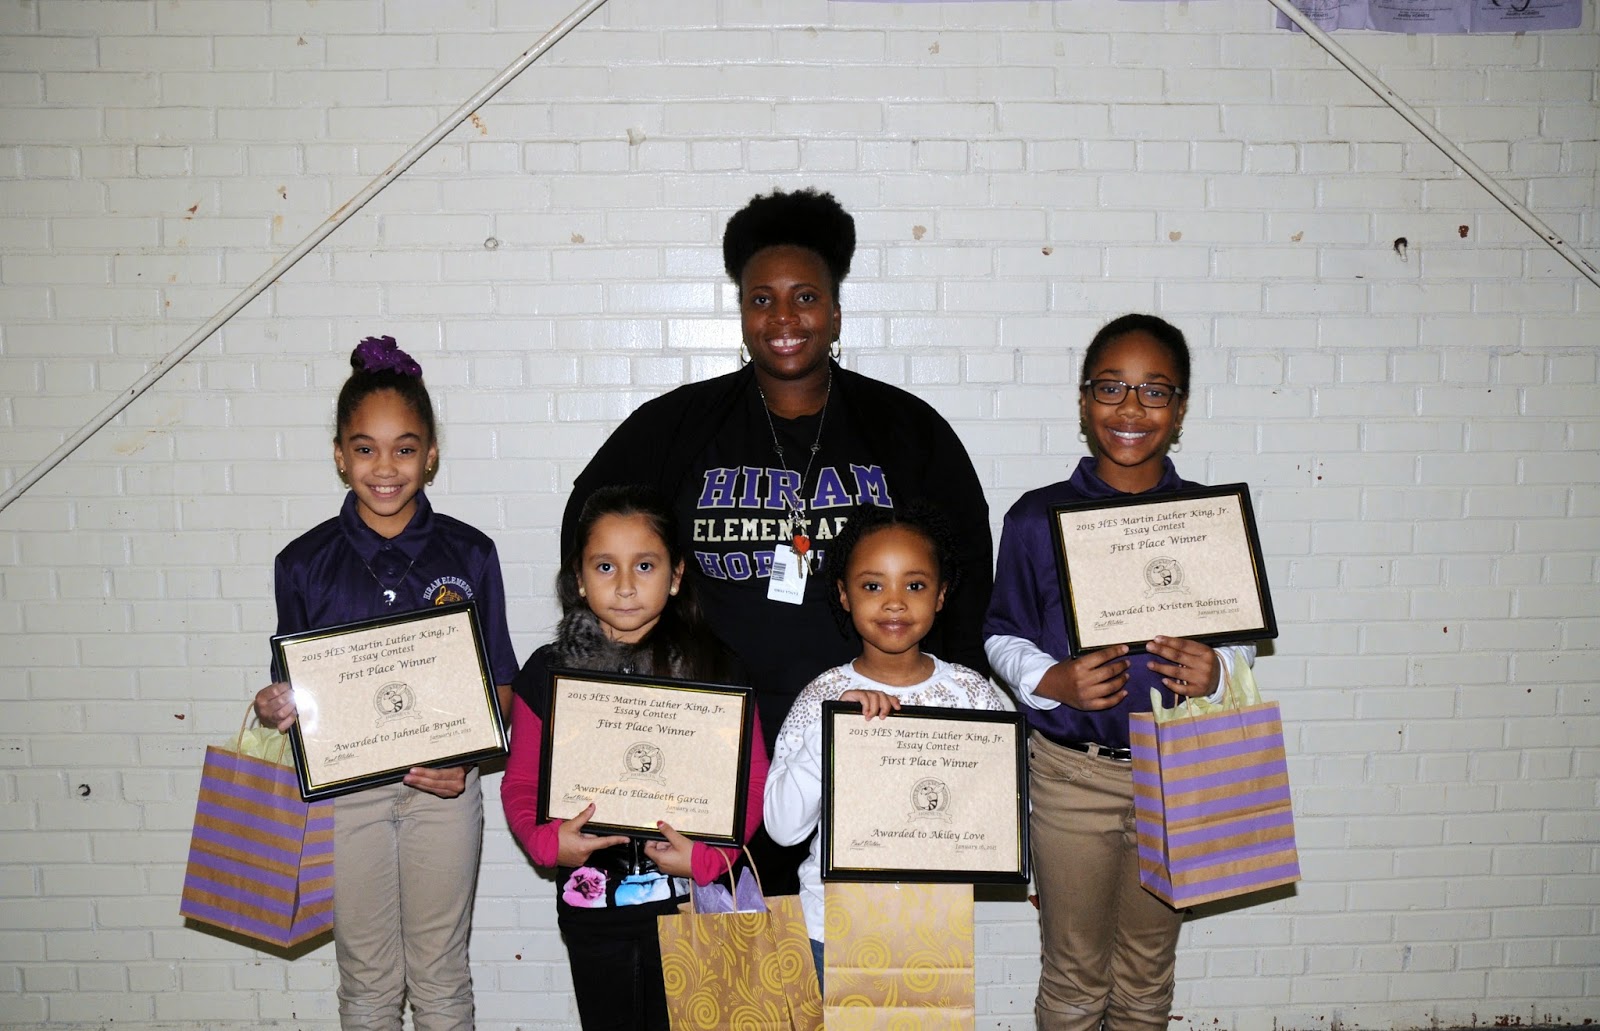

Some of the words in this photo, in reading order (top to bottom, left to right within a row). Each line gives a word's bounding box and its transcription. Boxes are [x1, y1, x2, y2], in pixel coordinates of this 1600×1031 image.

[697, 463, 893, 510] HIRAM
[1077, 522, 1095, 531] 2015
[1098, 519, 1118, 529] HES
[1120, 515, 1154, 526] Martin
[1157, 511, 1187, 522] Luther
[1189, 508, 1215, 518] King,
[1217, 507, 1229, 516] Jr.
[1124, 525, 1149, 536] Essay
[1152, 521, 1185, 531] Contest
[1110, 543, 1134, 554] First
[1138, 538, 1165, 550] Place
[1168, 534, 1207, 545] Winner
[423, 578, 442, 600] HIRAM
[1100, 605, 1143, 618] Awarded
[1146, 604, 1155, 612] to
[1157, 600, 1193, 612] Kristen
[1195, 597, 1238, 607] Robinson
[302, 652, 322, 662] 2015
[324, 648, 345, 658] HES
[348, 640, 382, 653] Martin
[385, 633, 416, 647] Luther
[419, 627, 444, 640] King,
[446, 625, 458, 635] Jr.
[352, 652, 378, 664] Essay
[381, 644, 414, 658] Contest
[338, 670, 363, 684] First
[367, 663, 395, 677] Place
[398, 655, 437, 669] Winner
[568, 692, 587, 701] 2015
[589, 693, 610, 702] HES
[613, 696, 647, 706] Martin
[649, 699, 682, 709] Luther
[685, 702, 710, 714] King,
[712, 705, 725, 714] Jr.
[614, 706, 640, 717] Essay
[643, 709, 677, 720] Contest
[333, 736, 378, 753] Awarded
[381, 734, 390, 742] to
[392, 724, 430, 741] Jahnelle
[433, 717, 466, 733] Bryant
[596, 719, 622, 729] First
[625, 722, 653, 733] Place
[656, 724, 696, 737] Winner
[849, 728, 868, 737] 2015
[871, 729, 892, 737] HES
[895, 730, 929, 739] Martin
[932, 732, 963, 740] Luther
[965, 734, 990, 744] King,
[992, 735, 1004, 743] Jr.
[897, 741, 923, 751] Essay
[926, 743, 960, 751] Contest
[880, 756, 906, 767] First
[909, 756, 937, 767] Place
[940, 757, 979, 769] Winner
[572, 784, 615, 795] Awarded
[619, 789, 628, 797] to
[631, 789, 674, 802] Elizabeth
[677, 795, 708, 805] Garcia
[871, 829, 915, 838] Awarded
[918, 831, 927, 839] to
[929, 831, 960, 841] Akiley
[963, 832, 985, 840] Love
